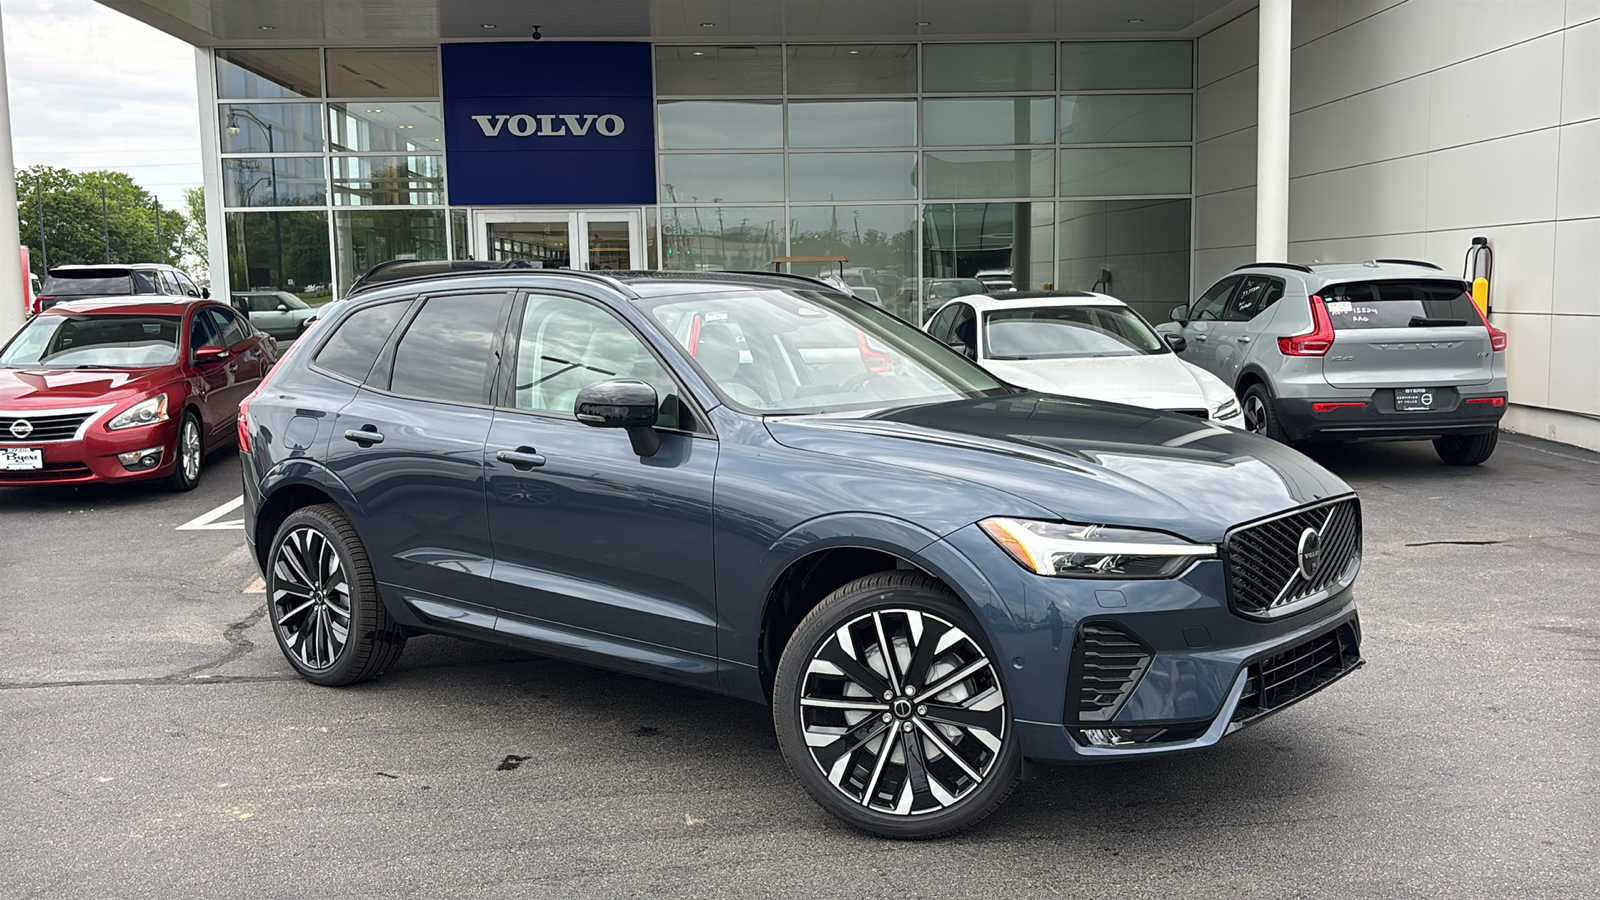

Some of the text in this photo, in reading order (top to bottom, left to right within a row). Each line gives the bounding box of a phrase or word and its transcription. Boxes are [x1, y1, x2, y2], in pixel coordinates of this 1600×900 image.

[471, 114, 625, 137] VOLVO
[663, 224, 694, 235] Cars
[1381, 342, 1453, 350] VOLVO
